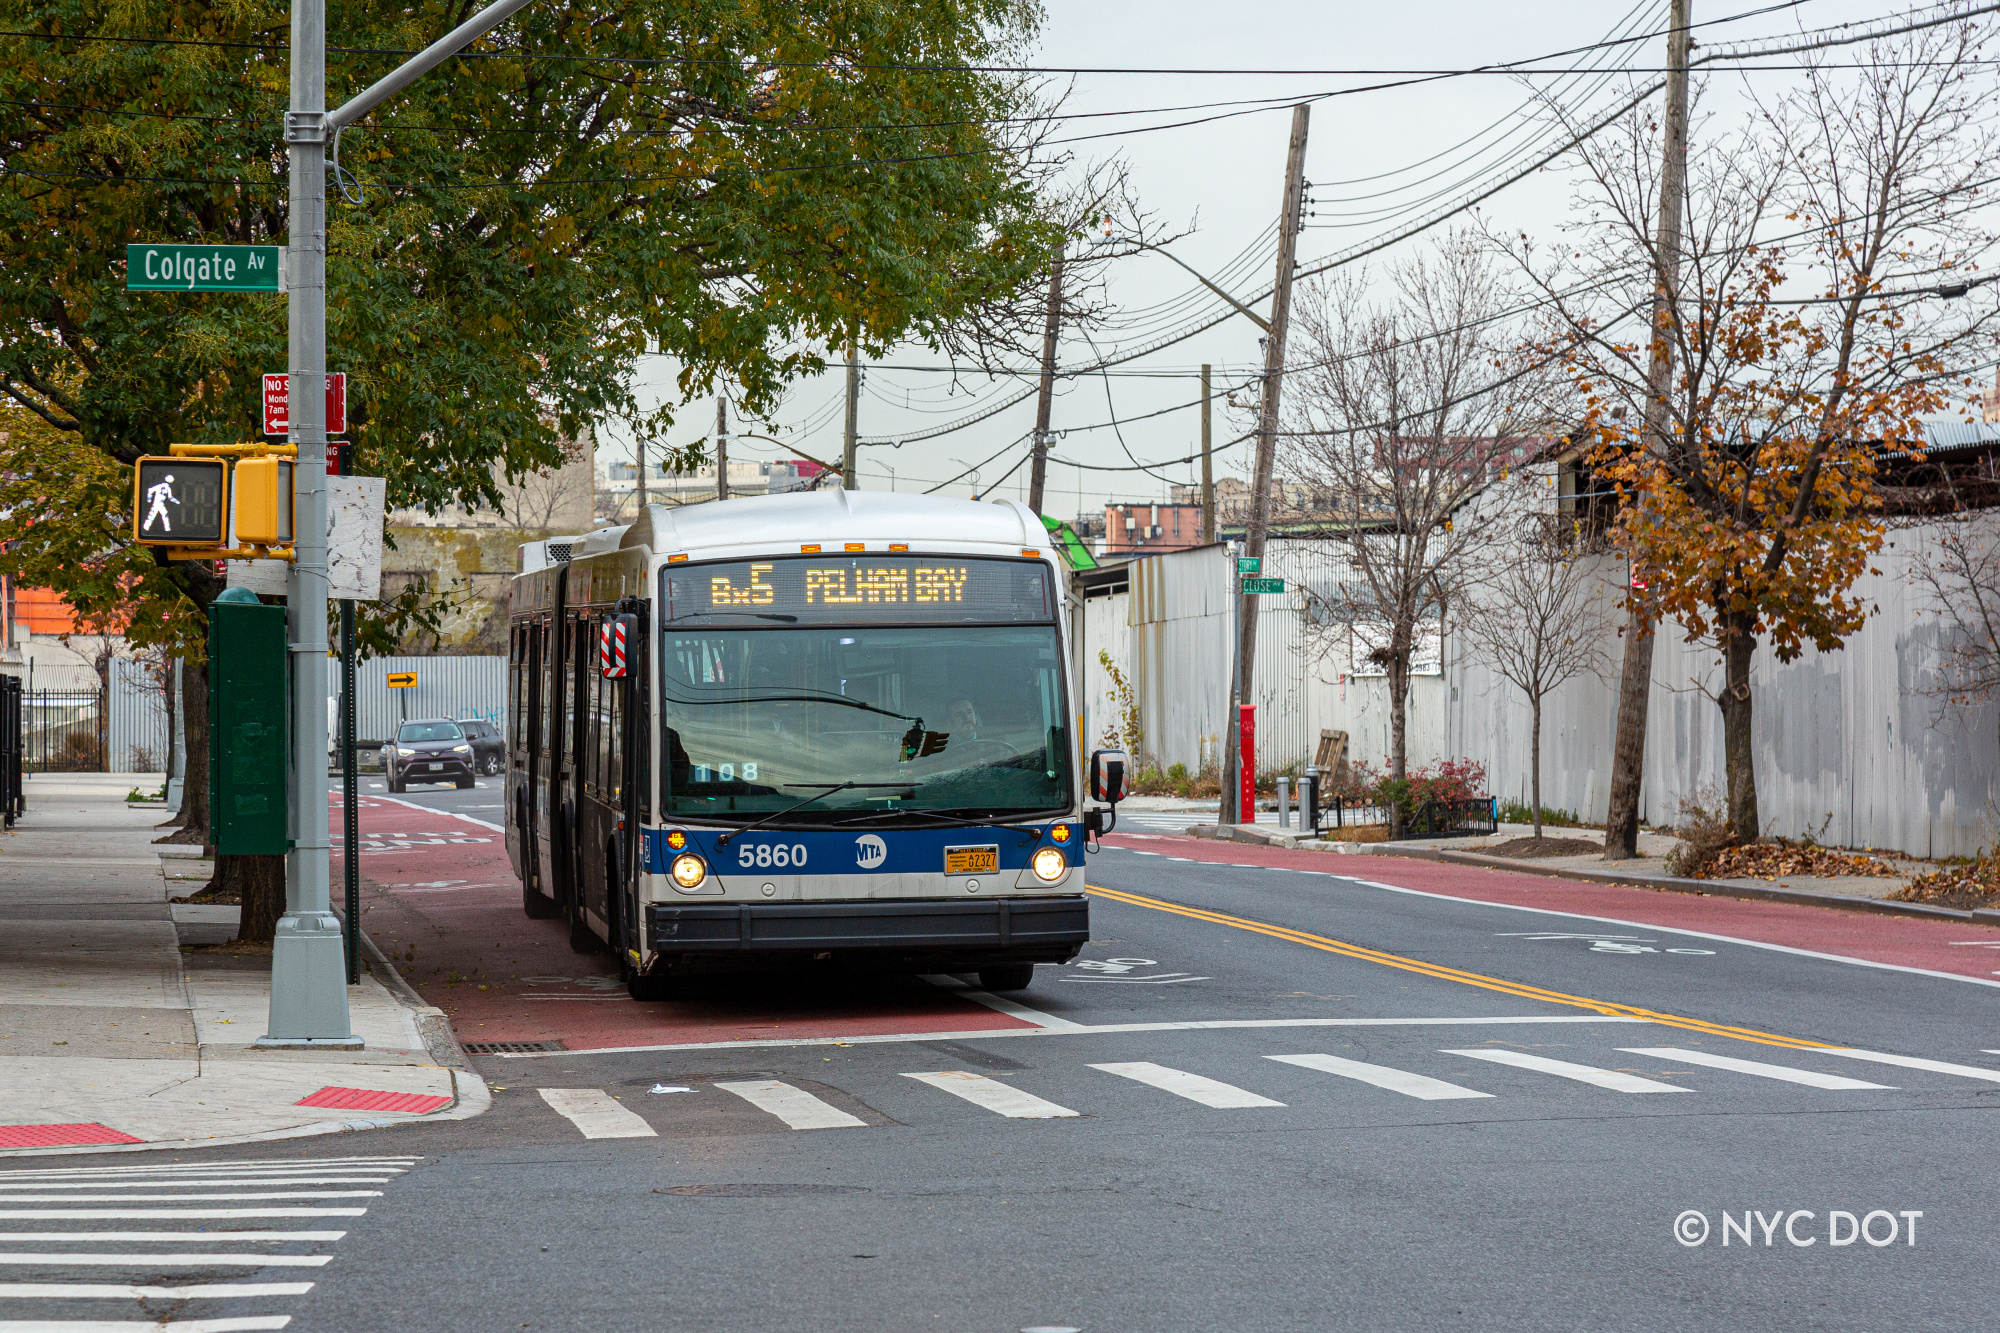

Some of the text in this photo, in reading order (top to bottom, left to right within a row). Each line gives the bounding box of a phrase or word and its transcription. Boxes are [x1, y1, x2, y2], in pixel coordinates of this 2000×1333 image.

[145, 249, 266, 289] Colgate Av
[268, 380, 282, 391] NO
[268, 394, 289, 404] Mond
[268, 405, 285, 414] 7am
[711, 563, 967, 605] Bx5 PELHAM BAY
[1243, 579, 1271, 592] CLOSE
[738, 841, 883, 868] 5860 MTA
